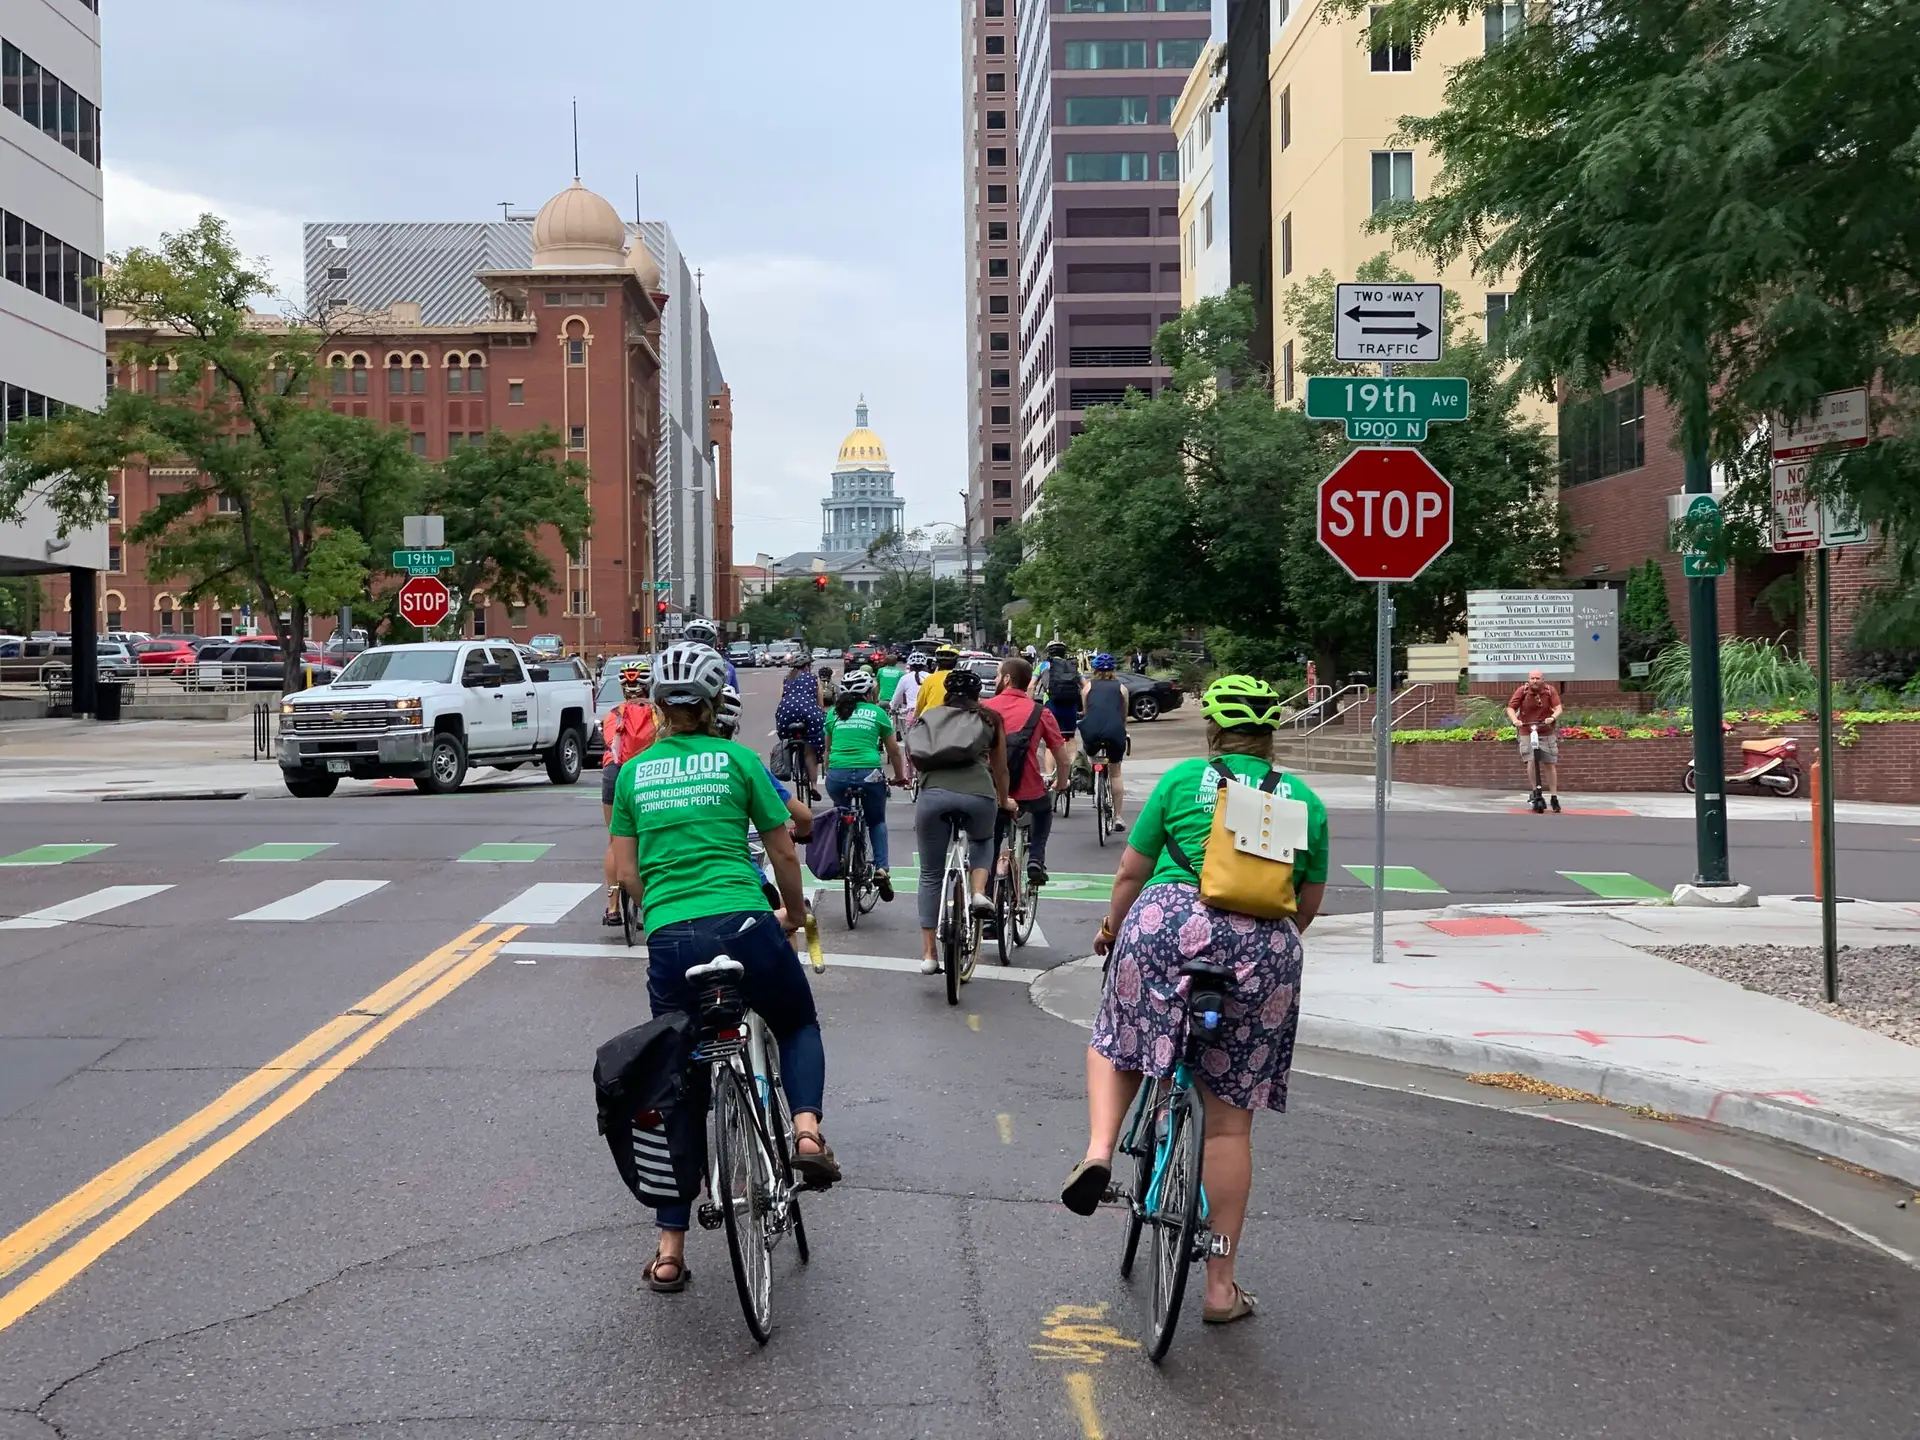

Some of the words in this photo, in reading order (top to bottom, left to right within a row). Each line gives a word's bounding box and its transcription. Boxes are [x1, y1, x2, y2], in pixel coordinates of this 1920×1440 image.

[1354, 291, 1383, 302] TWO
[1390, 291, 1424, 302] WAY
[1358, 343, 1418, 354] TRAFFIC
[1345, 383, 1416, 413] 19th
[1431, 391, 1458, 407] Ave
[1354, 421, 1397, 438] 1900
[1407, 423, 1420, 437] N
[1787, 467, 1805, 484] NO
[1328, 489, 1443, 538] STOP
[1788, 505, 1806, 517] ANY
[1787, 516, 1807, 529] TIME
[407, 554, 435, 565] 19th
[403, 592, 446, 612] STOP
[1535, 605, 1550, 613] LAW
[1553, 605, 1571, 613] FIRM
[638, 762, 671, 779] 5280
[674, 752, 729, 777] LOOP
[634, 779, 665, 790] DOWNTOWN
[666, 776, 688, 785] DENVER
[689, 772, 730, 781] PARTNERSHIP
[660, 784, 732, 798] NEIGHBORHOODS,
[641, 798, 688, 813] CONNECTING
[690, 796, 721, 805] PEOPLE
